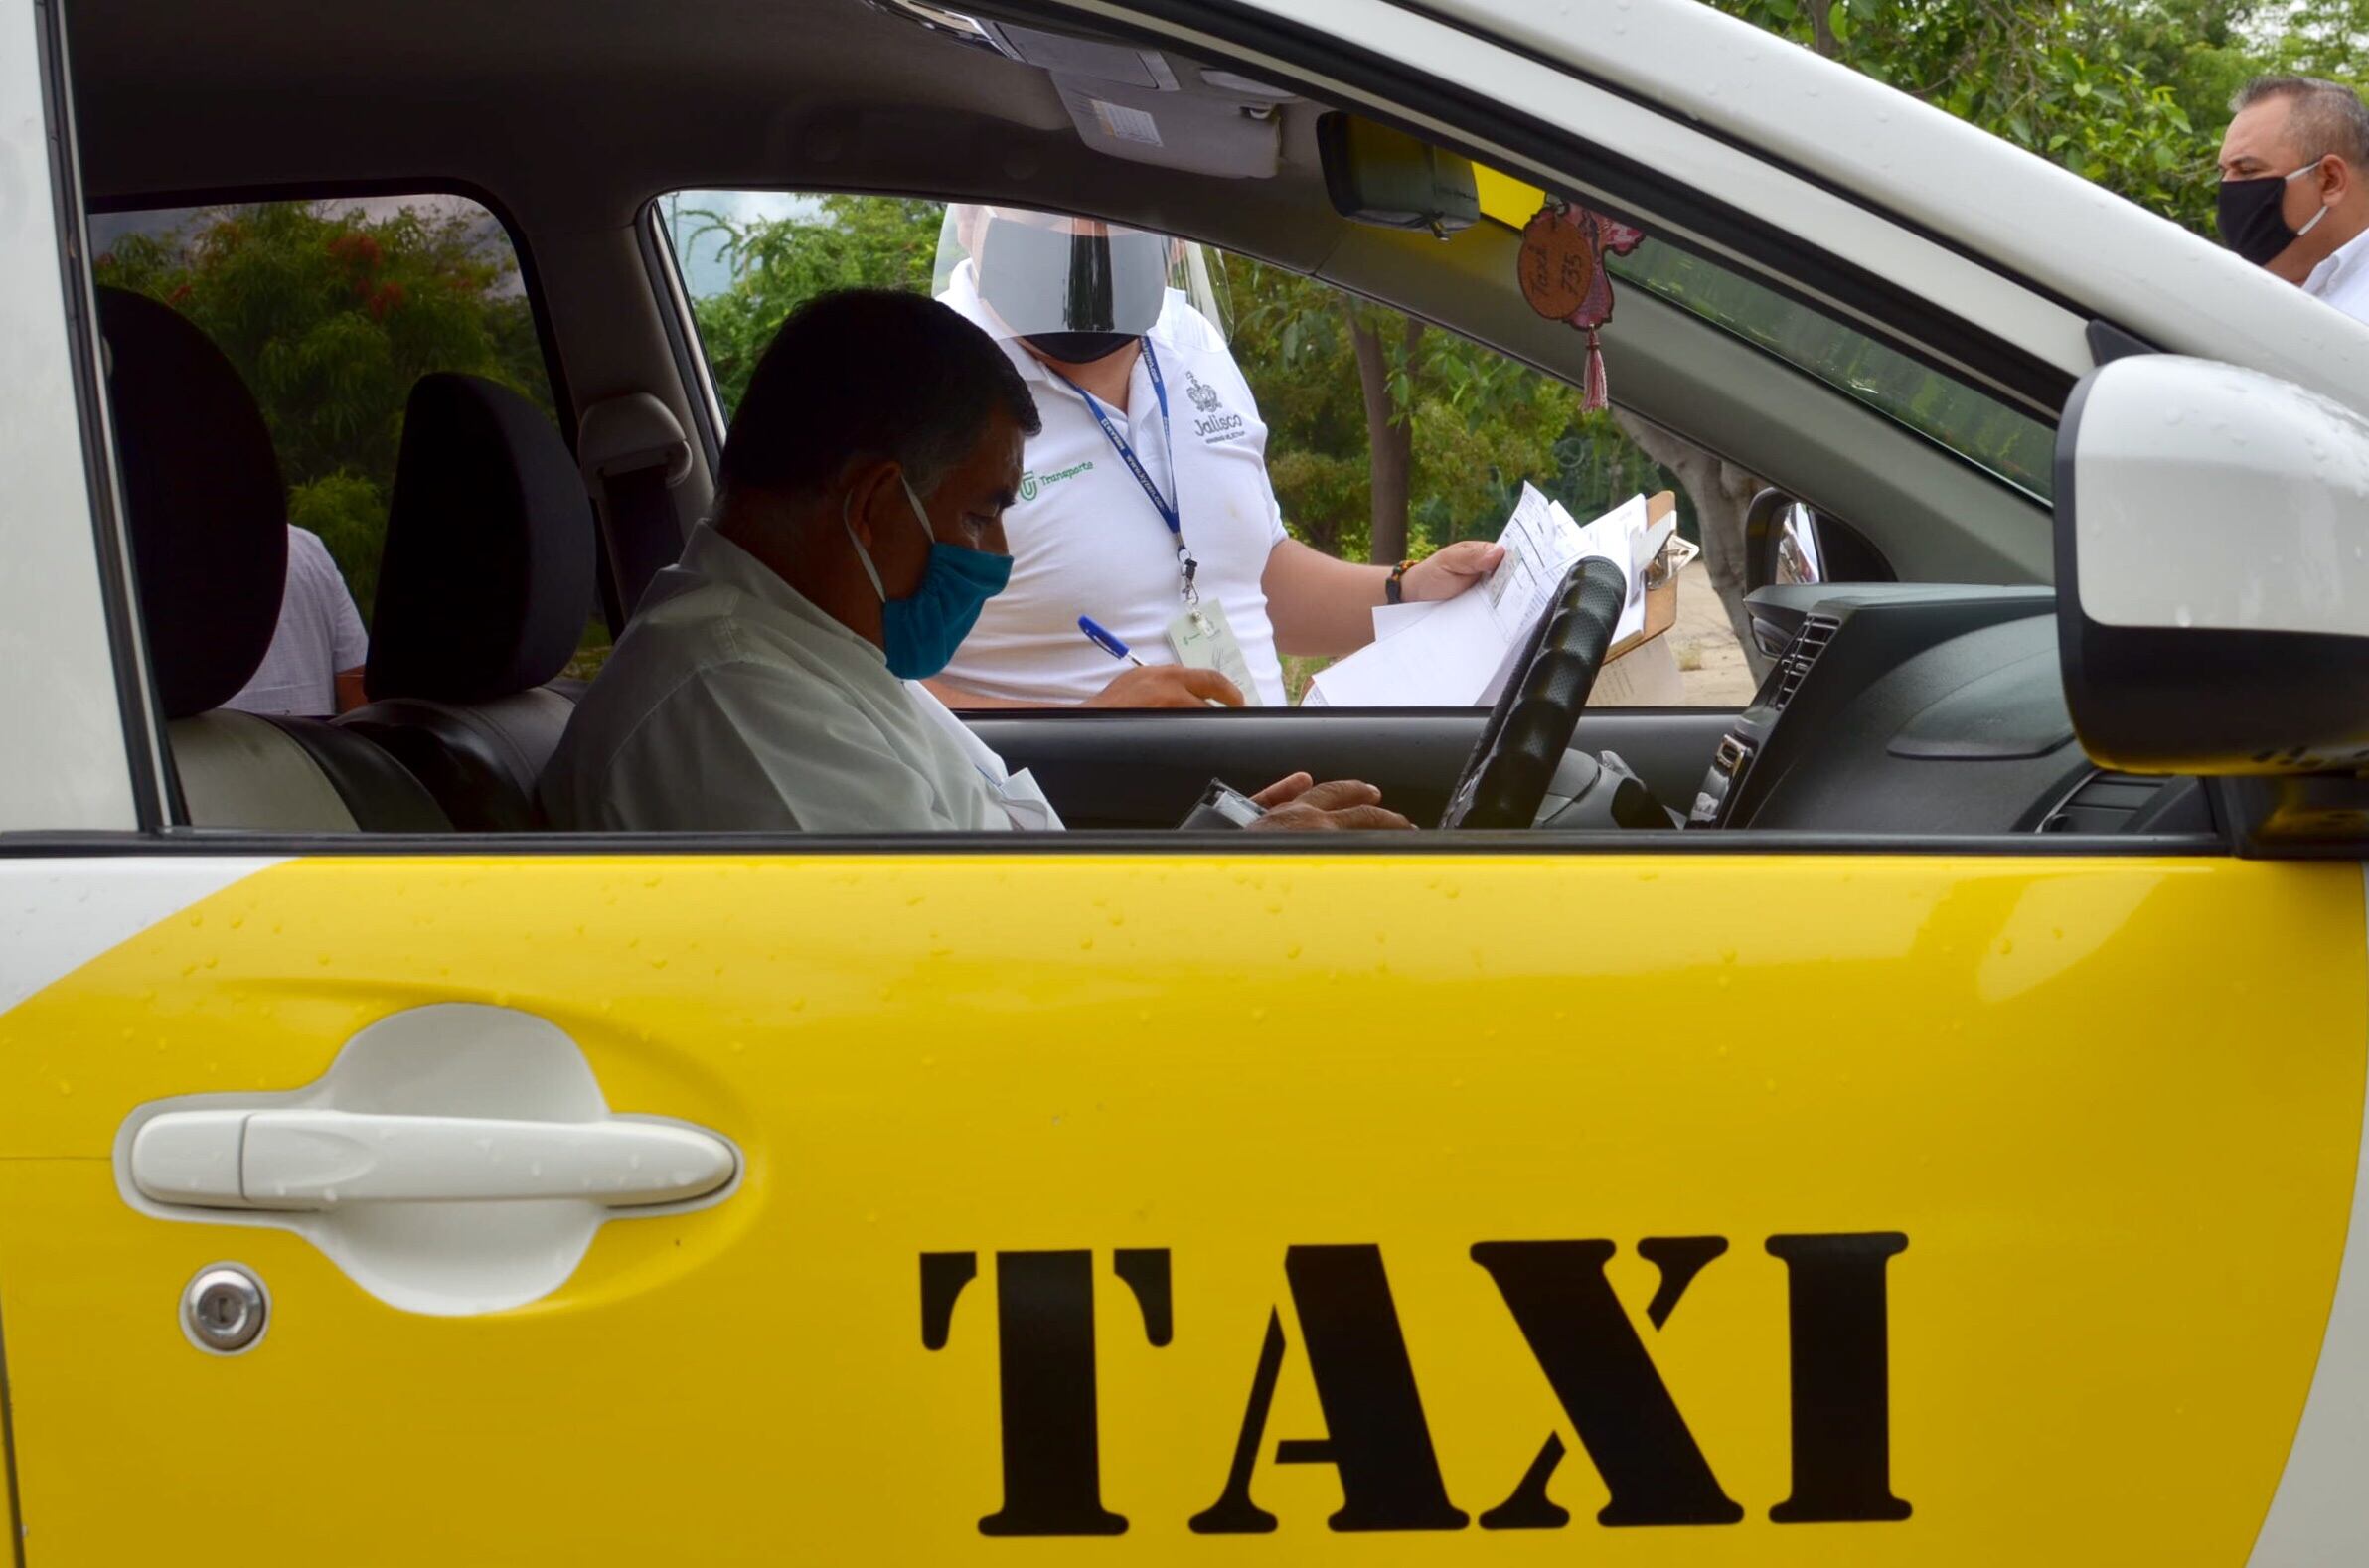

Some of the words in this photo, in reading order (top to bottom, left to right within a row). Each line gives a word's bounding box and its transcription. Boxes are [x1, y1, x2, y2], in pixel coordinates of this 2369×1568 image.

[1194, 413, 1243, 436] Jalisco
[1039, 460, 1094, 486] Transporte
[919, 1231, 1913, 1537] TAXI
